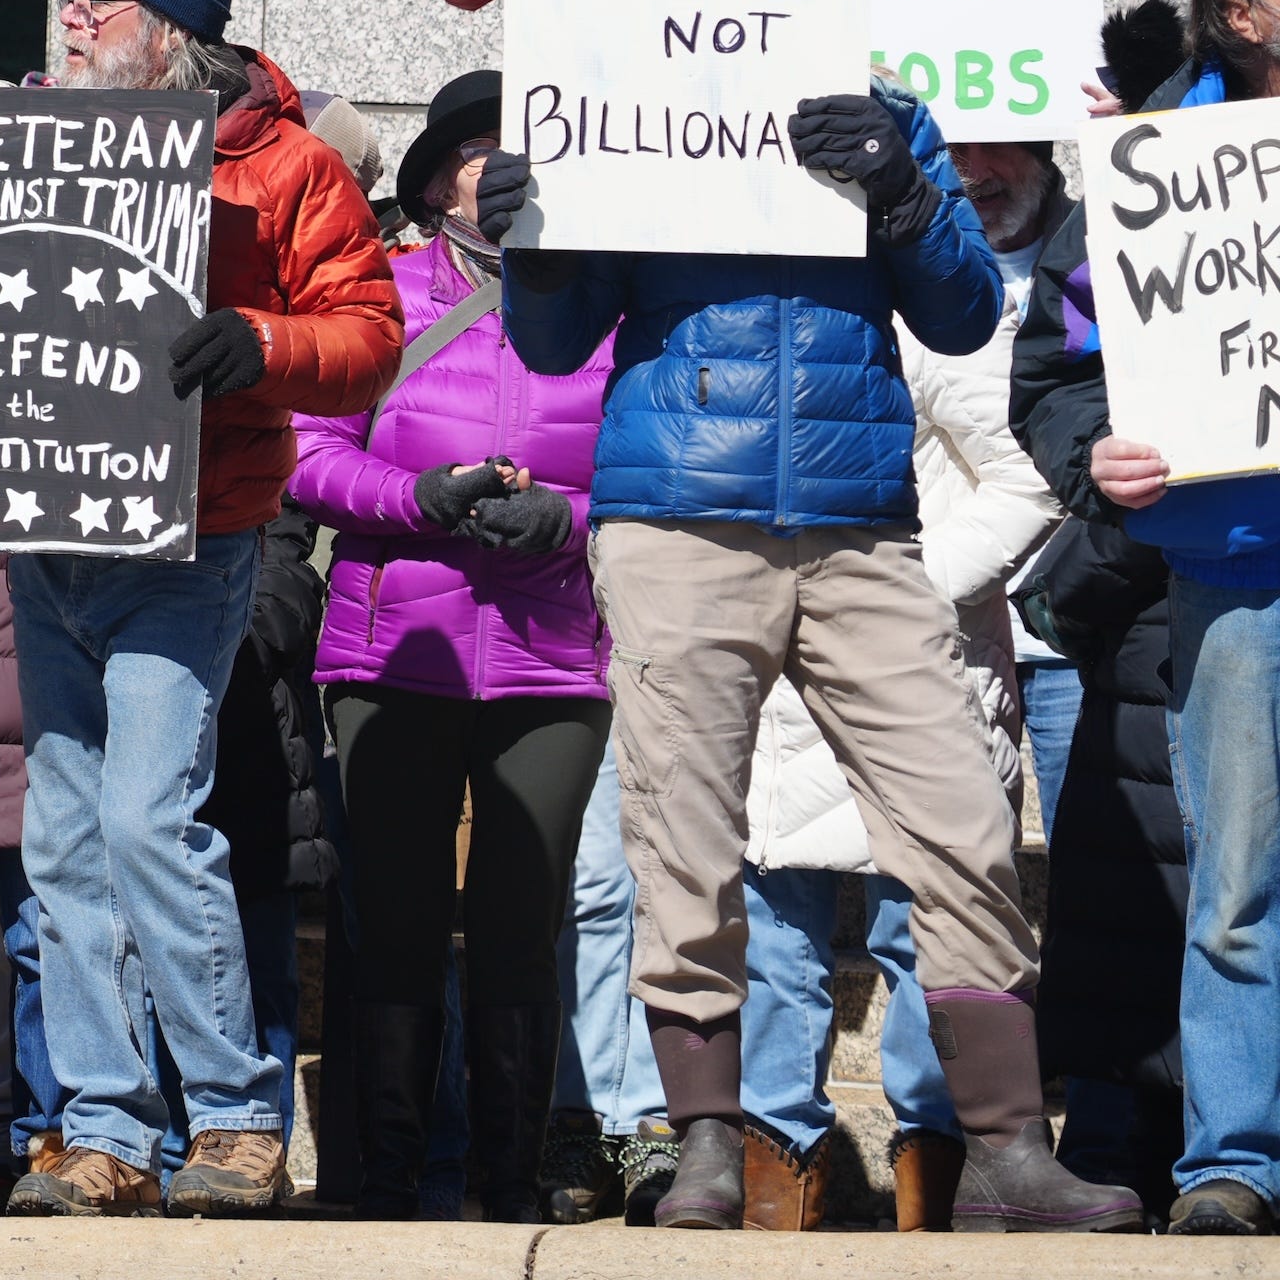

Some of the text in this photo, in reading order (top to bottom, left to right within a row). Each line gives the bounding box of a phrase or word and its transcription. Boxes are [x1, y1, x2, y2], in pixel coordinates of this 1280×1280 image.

[664, 11, 791, 58] NOT
[871, 48, 1050, 115] OBS
[523, 83, 787, 165] BILLIONA
[78, 177, 211, 293] TRUMP
[1117, 220, 1280, 326] WORK
[6, 389, 55, 422] the
